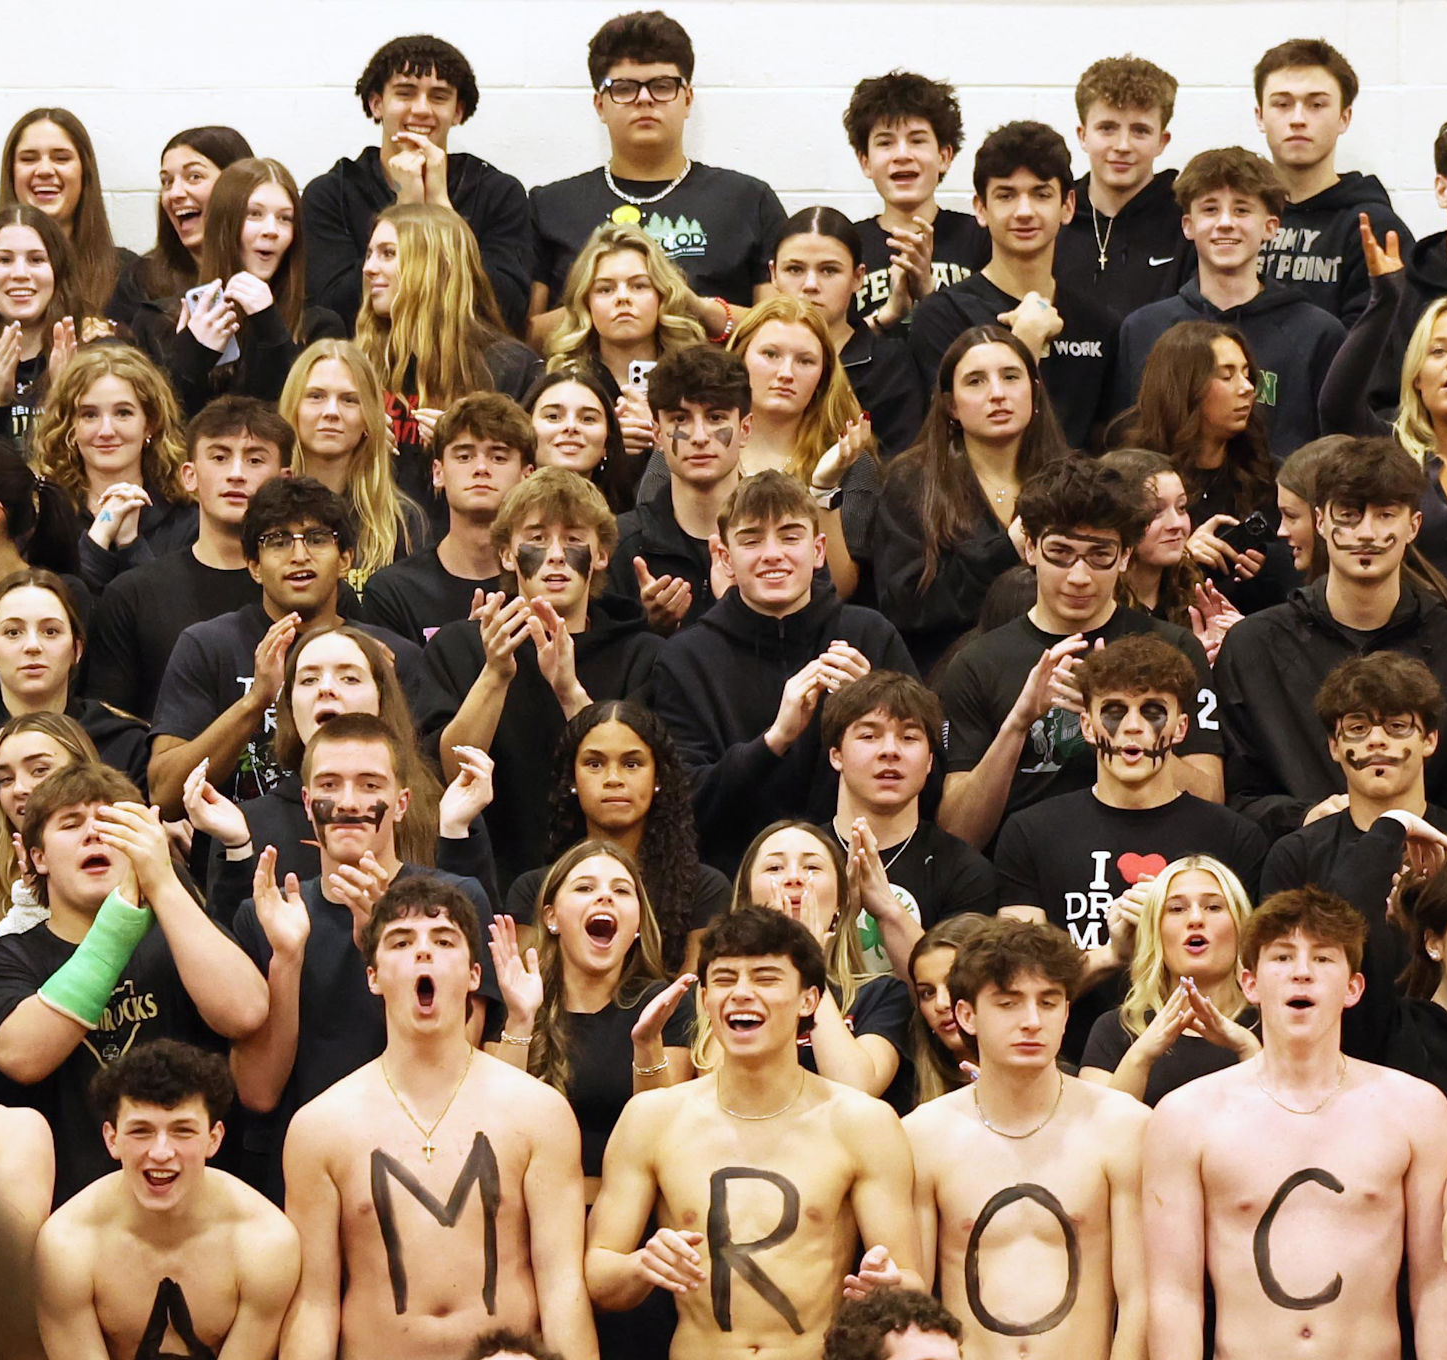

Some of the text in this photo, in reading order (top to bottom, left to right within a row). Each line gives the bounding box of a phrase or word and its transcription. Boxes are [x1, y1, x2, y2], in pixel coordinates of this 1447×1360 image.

[1276, 254, 1342, 283] POINT
[1053, 340, 1102, 357] WORK
[1197, 688, 1219, 730] 2
[1089, 851, 1111, 890] I
[1064, 892, 1114, 920] DR
[98, 993, 158, 1031] ROCKS
[370, 1132, 501, 1316] M
[707, 1167, 804, 1335] R
[965, 1182, 1081, 1337] O
[1252, 1168, 1345, 1311] C
